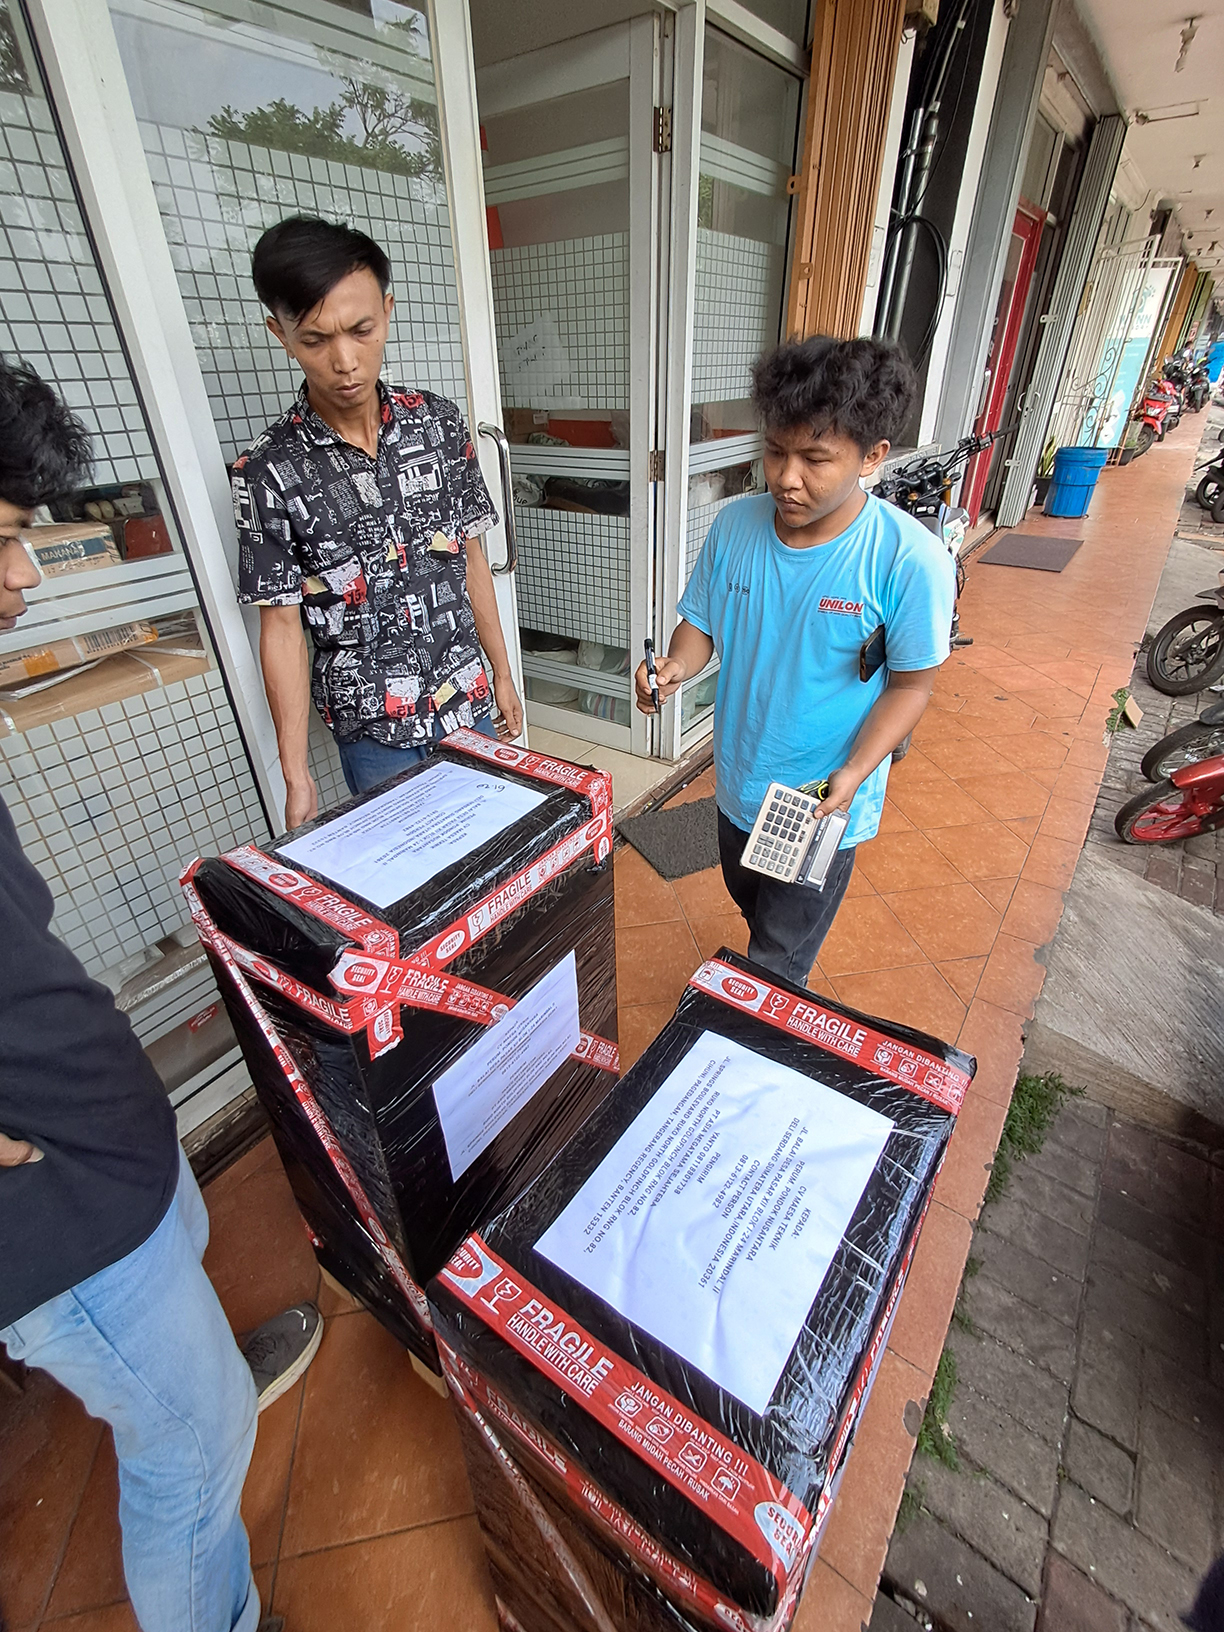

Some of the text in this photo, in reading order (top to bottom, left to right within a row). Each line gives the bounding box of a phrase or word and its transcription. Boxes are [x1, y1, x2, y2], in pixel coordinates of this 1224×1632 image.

[819, 598, 864, 613] UNILON
[539, 759, 589, 781] FRAGILE
[488, 871, 532, 914] FRAGILE
[316, 894, 373, 927] FRAGILE
[439, 932, 462, 953] SECURITY
[351, 965, 376, 976] SECURITY
[352, 973, 366, 983] SEAL
[402, 968, 450, 994] FRAGILE
[398, 986, 418, 999] HANDLE
[728, 978, 755, 995] SECURITY
[730, 986, 745, 998] SEAL
[295, 985, 351, 1023] FRAGILE
[786, 1016, 861, 1058] HANDLE WITH CARE
[792, 1002, 868, 1046] FRAGILE
[882, 1040, 915, 1058] JANGAN
[916, 1053, 960, 1083] DIBANTING
[682, 1086, 709, 1119] BOULEVARD
[705, 1090, 720, 1106] RUKO
[670, 1118, 686, 1136] RUKO
[690, 1105, 710, 1127] NORTH
[787, 1116, 800, 1132] DELI
[643, 1116, 674, 1153] TANGERANG
[654, 1134, 674, 1158] NORTH
[666, 1126, 696, 1162] GOLDFINCH
[701, 1130, 720, 1152] YANTO
[769, 1130, 792, 1162] SERDANG
[787, 1136, 804, 1158] BALAI
[648, 1108, 721, 1208] PT ASIA MEGATAMA SEJAHTERA
[654, 1160, 671, 1180] BLOK
[695, 1151, 721, 1184] PENGIRIM
[778, 1156, 792, 1174] DESA
[626, 1156, 658, 1196] GOLDFINCH
[643, 1178, 658, 1194] RNG
[720, 1158, 761, 1219] CONTACT PERSON
[749, 1160, 774, 1196] SUMATERA
[765, 1172, 783, 1197] PASAR
[599, 1183, 624, 1212] BANTEN
[613, 1194, 631, 1215] BLOK
[744, 1159, 805, 1262] PERUM. PONDOK NUSANTARA
[758, 1195, 770, 1208] XII
[582, 1211, 603, 1236] 15332
[601, 1213, 617, 1231] RNG
[748, 1206, 764, 1227] BLOK
[768, 1184, 807, 1251] CV MAESA TEKNIK
[790, 1207, 811, 1240] KEPADA:
[459, 1247, 480, 1270] URITY
[715, 1242, 744, 1286] MARINDAL
[697, 1262, 716, 1288] 20361
[519, 1299, 615, 1381] FRAGILE
[506, 1313, 599, 1396] HANDLE WITH CARE
[631, 1381, 674, 1419] JANGAN
[673, 1413, 733, 1464] DIBANTING
[733, 1458, 750, 1477] !!!
[618, 1419, 642, 1443] BARANG
[642, 1437, 664, 1461] MUDAH
[663, 1455, 685, 1479] PECAH
[687, 1476, 711, 1502] RUSAK
